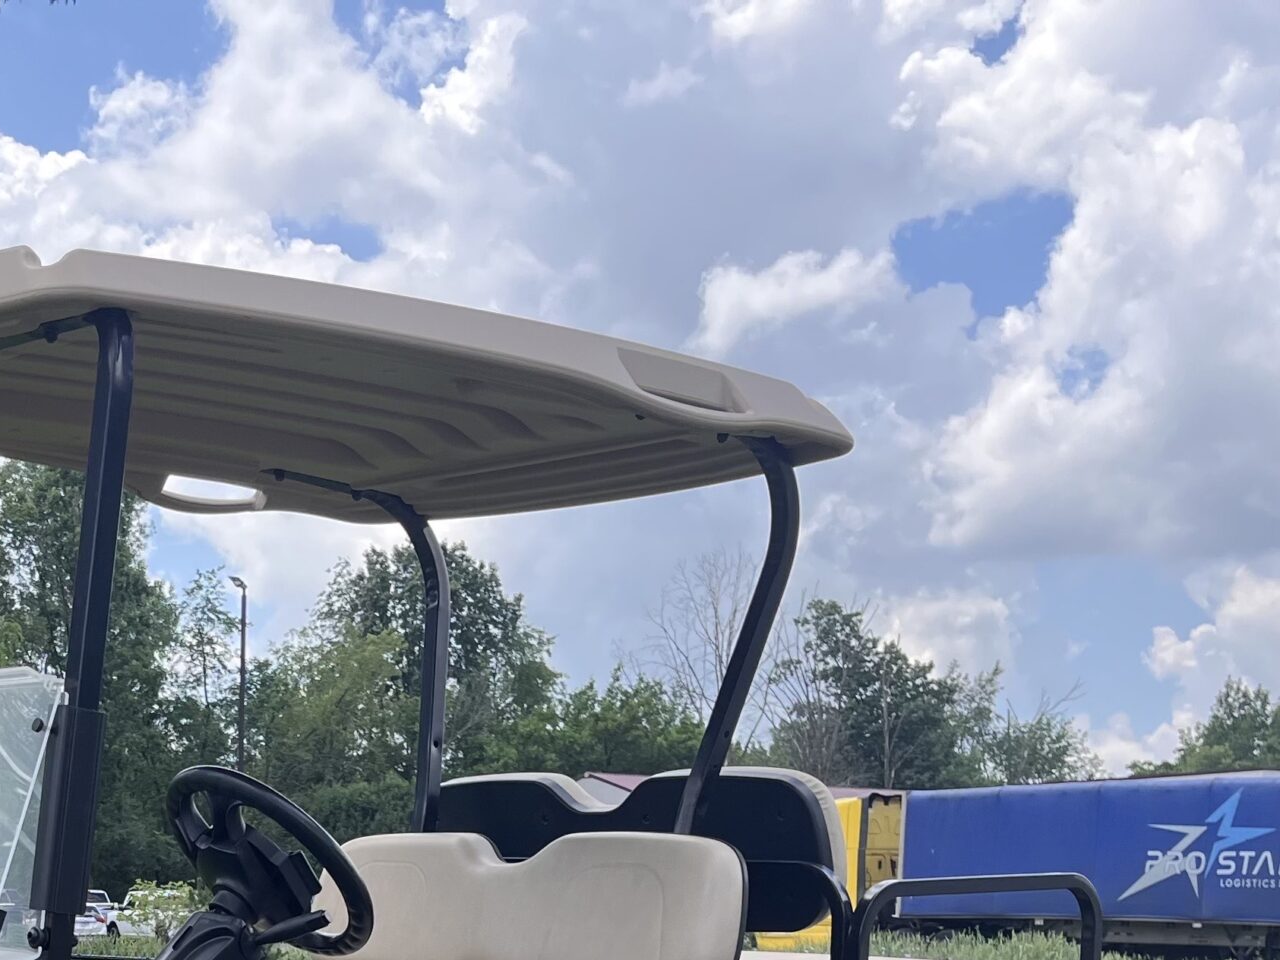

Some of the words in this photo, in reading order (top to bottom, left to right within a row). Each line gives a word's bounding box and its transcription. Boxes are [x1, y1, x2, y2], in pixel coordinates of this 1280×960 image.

[1145, 850, 1206, 875] PRO
[1216, 850, 1280, 876] STA
[1220, 878, 1276, 889] LOGISTICS
